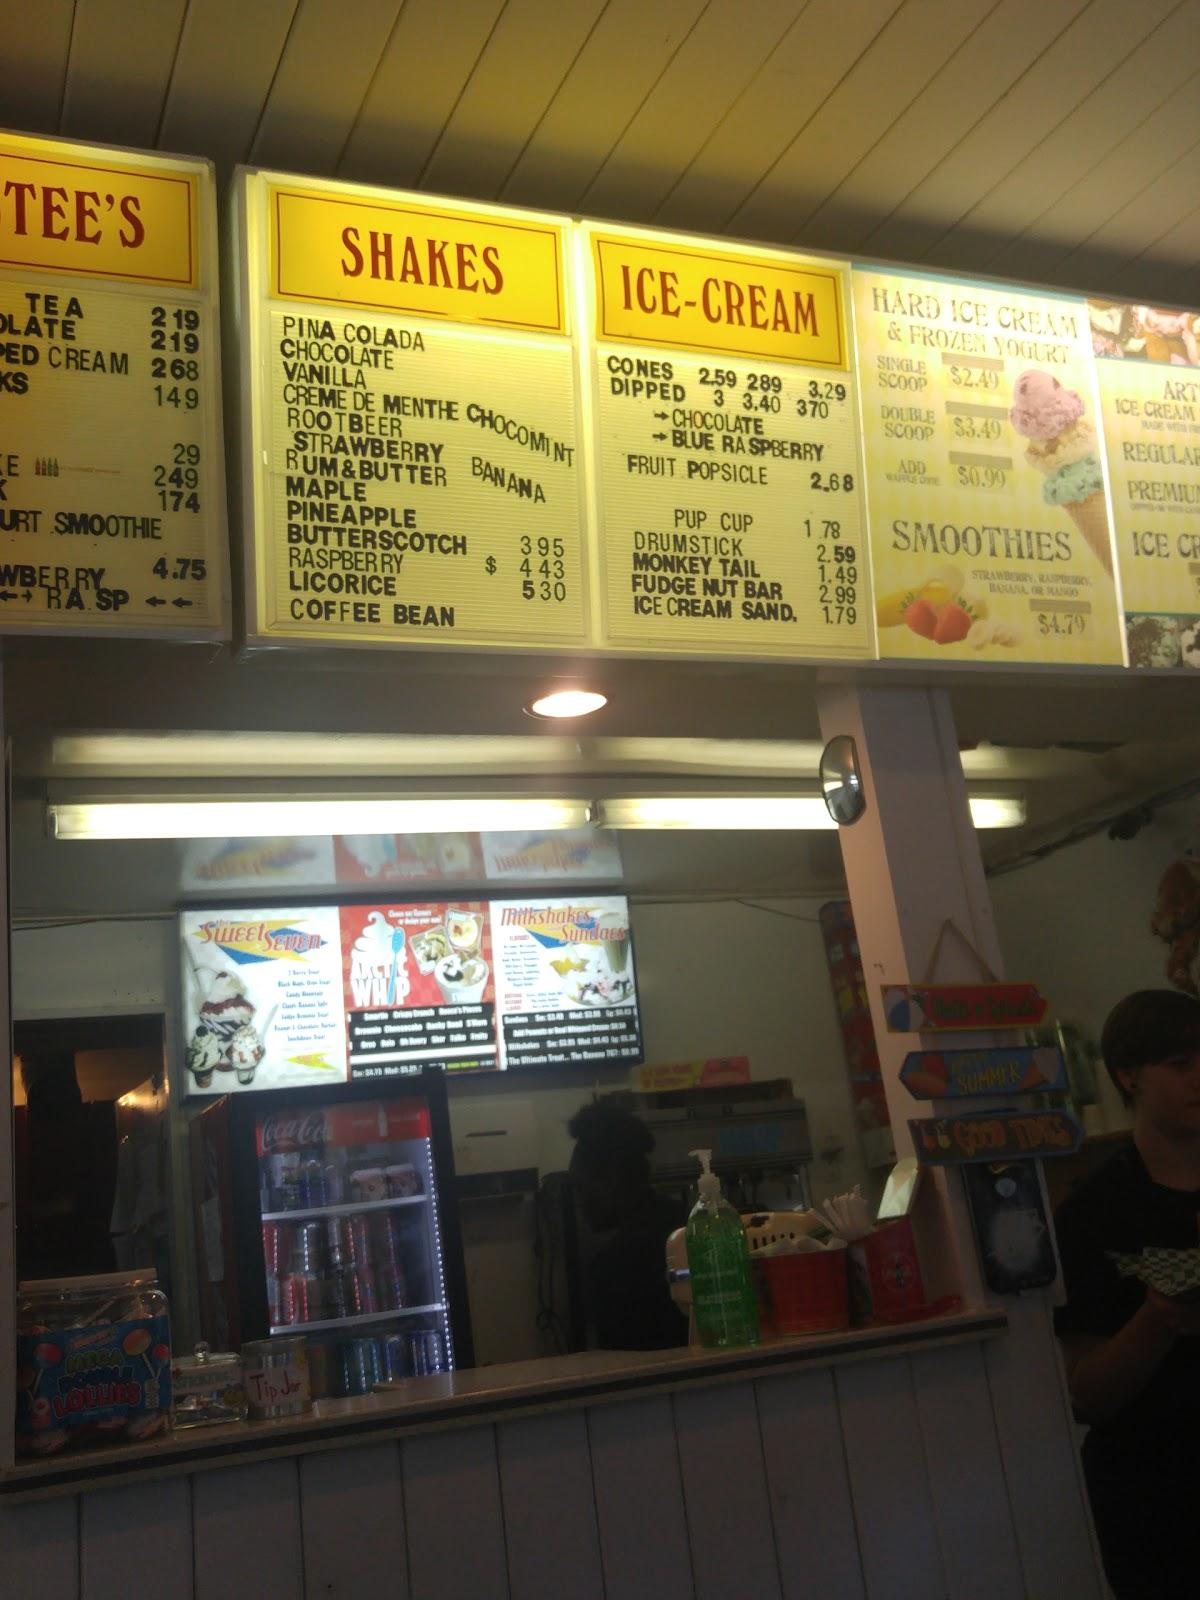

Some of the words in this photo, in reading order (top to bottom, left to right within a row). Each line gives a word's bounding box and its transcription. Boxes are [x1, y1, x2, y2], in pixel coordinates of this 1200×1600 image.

[3, 180, 146, 249] TEE'S
[340, 226, 504, 295] SHAKES
[25, 292, 84, 319] TEA
[151, 306, 200, 331] 219
[621, 264, 820, 338] ICE-CREAM
[872, 287, 941, 321] HARD
[951, 299, 989, 327] ICE
[997, 305, 1079, 339] CREAM
[151, 329, 200, 354] 219
[283, 316, 335, 341] PINA
[344, 323, 425, 351] COLADA
[887, 320, 902, 342] &
[909, 324, 986, 353] FROZEN
[993, 336, 1069, 364] YOGURT
[48, 346, 129, 375] CREAM
[151, 357, 200, 382] 268
[280, 338, 394, 370] CHOCOLATE
[283, 361, 366, 389] VANILLA
[607, 355, 674, 381] CONES
[699, 367, 737, 389] 2.59
[746, 372, 782, 394] 289
[808, 380, 847, 401] 3.29
[876, 355, 927, 375] SINGLE
[950, 366, 999, 390] $2.49
[878, 372, 928, 392] SCOOP
[154, 384, 200, 409] 149
[611, 377, 686, 402] DIPPED
[713, 389, 724, 408] 3
[742, 392, 782, 414] 3.40
[796, 398, 829, 419] 370
[1115, 398, 1140, 416] ICE
[1144, 400, 1196, 422] CREAM
[283, 384, 347, 410] CREME
[353, 391, 375, 412] DE
[383, 394, 459, 421] MENTHE
[466, 404, 575, 467] CHOCOMINT
[672, 408, 764, 435] CHOCOLATE
[880, 404, 936, 425] DOUBLE
[953, 416, 1002, 439] $3.49
[884, 422, 935, 441] SCOOP
[294, 430, 444, 463] STRAWBERRY
[672, 429, 715, 451] BLUE
[722, 434, 825, 462] RASPBERRY
[154, 465, 200, 489] 249
[286, 476, 367, 502] MAPLE
[471, 456, 546, 504] BANANA
[627, 454, 677, 477] FRUIT
[688, 460, 769, 485] POPSICLE
[810, 472, 855, 492] 2.68
[898, 458, 927, 476] ADD
[957, 465, 1006, 489] $0.99
[158, 490, 201, 514] 174
[287, 500, 417, 528] PINEAPPLE
[54, 511, 162, 540] SMOOTHIE
[674, 508, 707, 529] PUP
[720, 512, 753, 533] CUP
[287, 523, 467, 555] BUTTERSCOTCH
[520, 536, 564, 558] 395
[634, 531, 744, 557] DRUMSTICK
[817, 544, 856, 564] 2.59
[891, 519, 1072, 562] SMOOTHIES
[1132, 531, 1170, 558] ICE
[153, 557, 206, 580] 4.75
[289, 547, 404, 574] RASPBERRY
[485, 556, 497, 575] $
[519, 558, 565, 580] 443
[633, 552, 712, 576] MONKEY
[719, 558, 761, 578] TAIL
[819, 565, 857, 584] 1.49
[289, 570, 397, 597] LICORICE
[522, 580, 567, 602] 530
[632, 574, 697, 596] FUDGE
[702, 578, 738, 598] NUT
[744, 581, 783, 600] BAR
[819, 585, 856, 604] 2.99
[290, 598, 381, 623] COFFEE
[393, 603, 455, 627] BEAN
[634, 595, 663, 615] ICE
[667, 596, 732, 618] CREAM
[742, 601, 798, 623] SAND.
[822, 606, 857, 625] 1.79
[1038, 612, 1086, 636] $4.79
[501, 905, 593, 926] Milkshakes
[200, 920, 266, 944] Sweet
[263, 930, 322, 953] Seven
[561, 924, 625, 941] Sundaes
[250, 1373, 277, 1402] Tip
[281, 1370, 303, 1395] Jar
